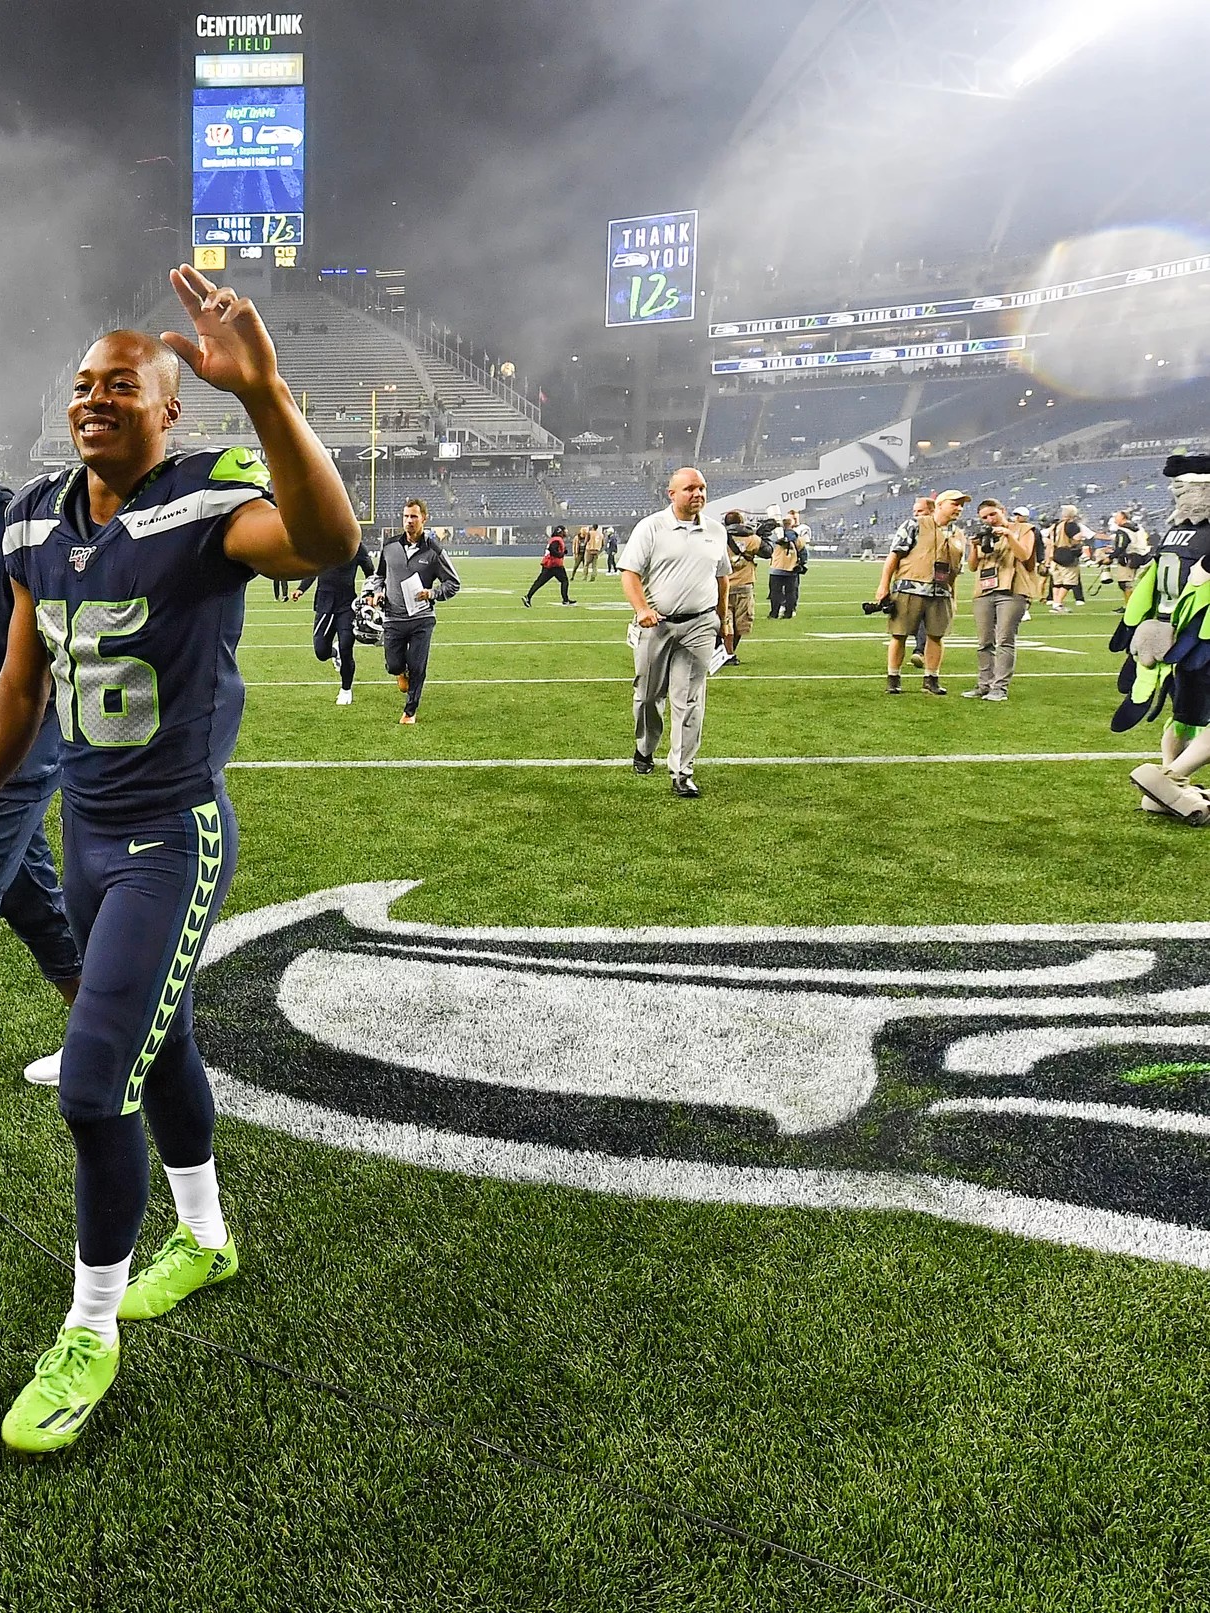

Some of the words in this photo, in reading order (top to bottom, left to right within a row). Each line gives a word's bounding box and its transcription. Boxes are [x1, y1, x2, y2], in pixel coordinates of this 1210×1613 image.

[228, 37, 271, 51] FIELD
[202, 63, 241, 78] BUD
[243, 62, 296, 77] LIGHT
[217, 217, 251, 229] THANK
[231, 229, 251, 242] YOU
[622, 222, 690, 249] THANK
[650, 246, 690, 270] YOU
[1157, 261, 1191, 278] THANK
[630, 273, 680, 319] 12s
[1011, 290, 1041, 306] THANK
[858, 310, 891, 322] THANK
[895, 307, 916, 318] YOU
[746, 320, 777, 333] THANK
[781, 318, 800, 329] YOU
[904, 345, 939, 357] THANK
[943, 344, 963, 355] YOU
[767, 357, 796, 369] THANK
[801, 355, 819, 366] YOU
[781, 485, 816, 503] Dream
[817, 465, 870, 491] Fearlessly
[136, 507, 188, 528] SEAHAWKS
[36, 597, 161, 747] 16
